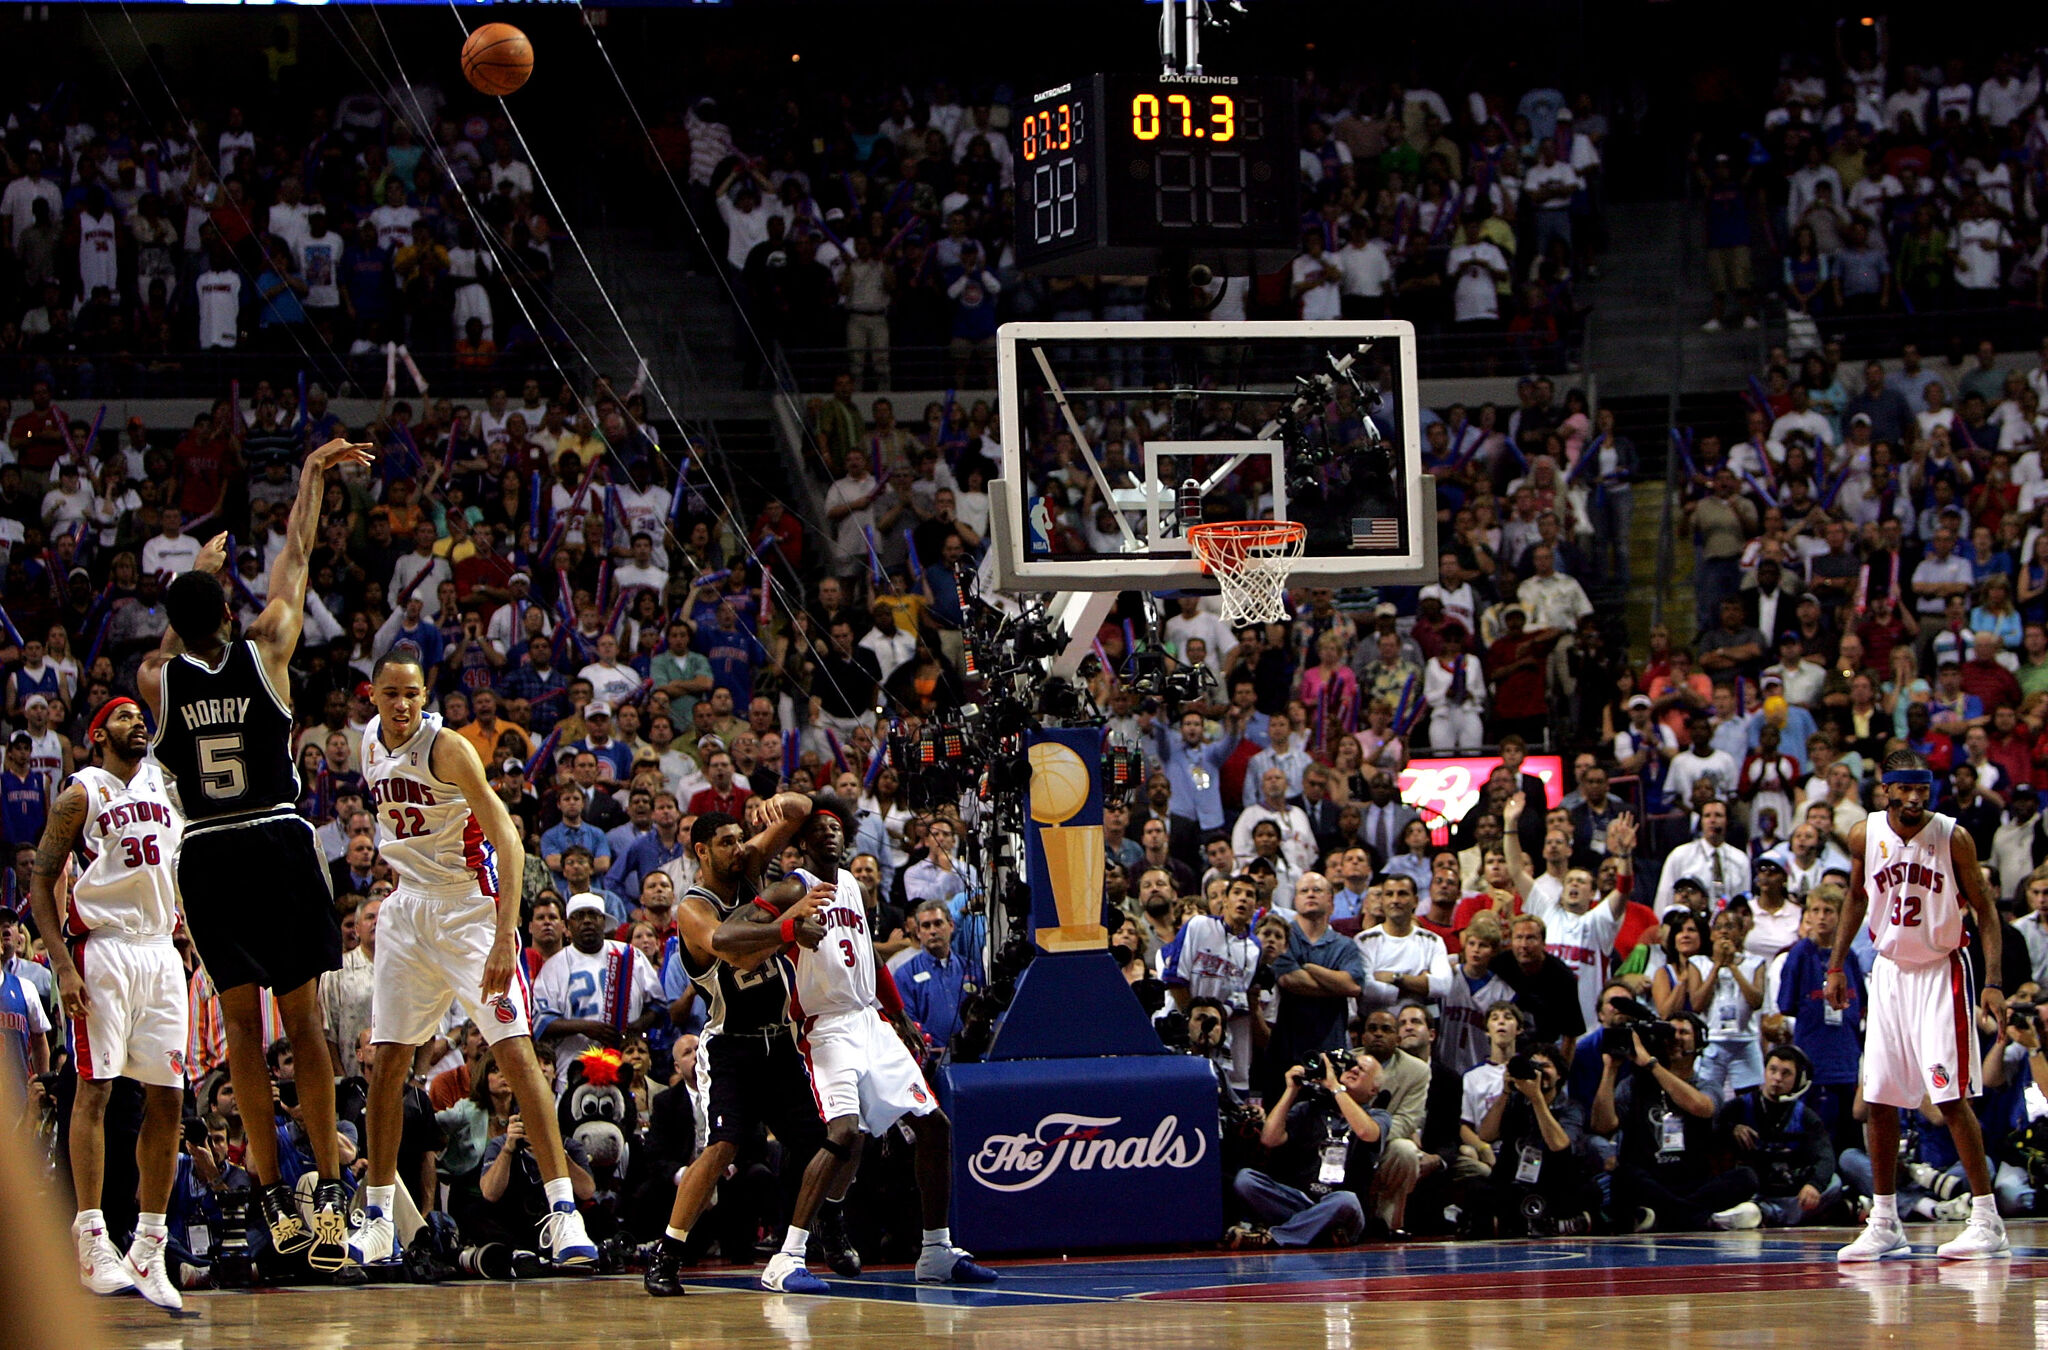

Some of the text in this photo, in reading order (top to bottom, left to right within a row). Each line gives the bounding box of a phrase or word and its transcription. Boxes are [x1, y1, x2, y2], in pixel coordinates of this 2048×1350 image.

[1159, 74, 1238, 85] DAKTRONICS
[1023, 104, 1070, 160] 07.3
[1133, 94, 1234, 141] 07.3
[1033, 541, 1047, 550] NBA
[463, 668, 491, 690] 40
[180, 697, 250, 731] HORRY
[196, 732, 248, 800] 5
[97, 801, 171, 837] PISTONS
[388, 807, 431, 840] 22
[121, 834, 160, 868] 36
[1873, 862, 1944, 894] PISTONS
[1891, 896, 1921, 927] 32
[839, 939, 856, 968] 3
[605, 954, 618, 1024] 800-333-R
[968, 1113, 1207, 1192] The Finals
